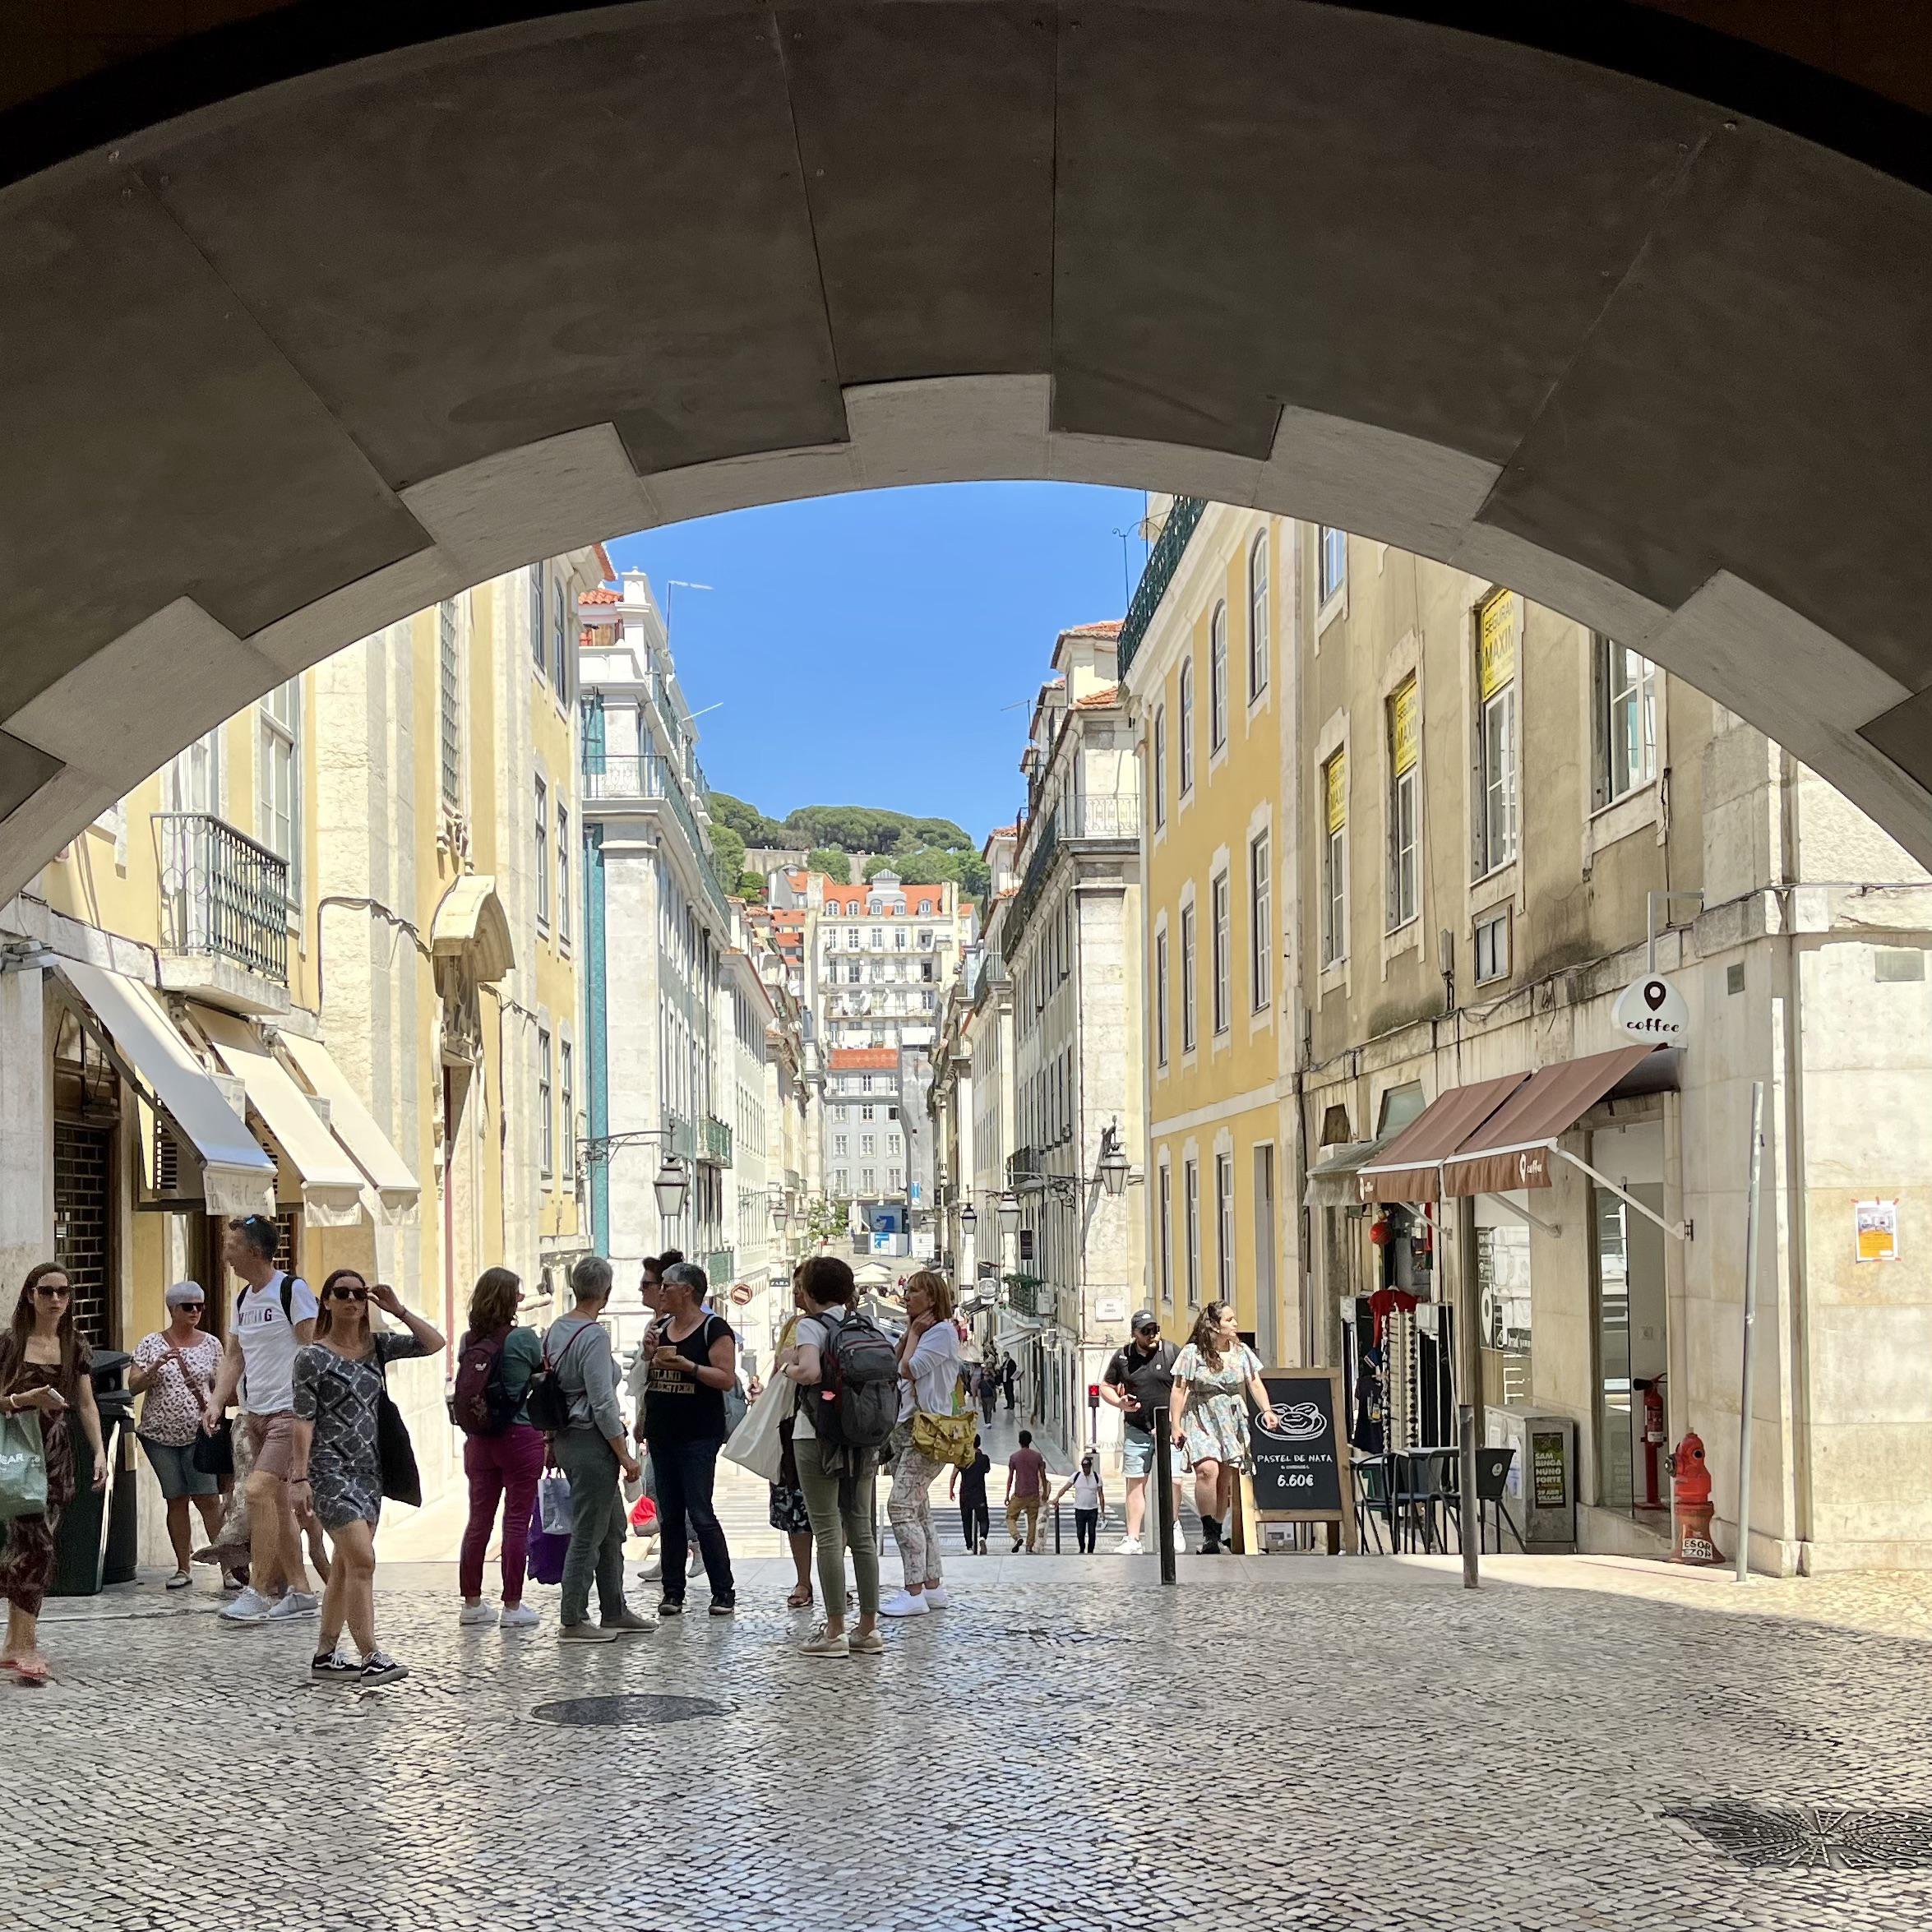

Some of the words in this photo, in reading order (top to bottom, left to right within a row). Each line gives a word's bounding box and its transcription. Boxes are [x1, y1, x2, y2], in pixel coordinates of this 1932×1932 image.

[1626, 1018, 1680, 1033] coffee
[1257, 1454, 1291, 1463] PASTEL
[1294, 1454, 1306, 1463] DE
[1308, 1454, 1333, 1463] NATA
[1535, 1467, 1561, 1476] NUNO
[1277, 1474, 1314, 1487] 6.60€
